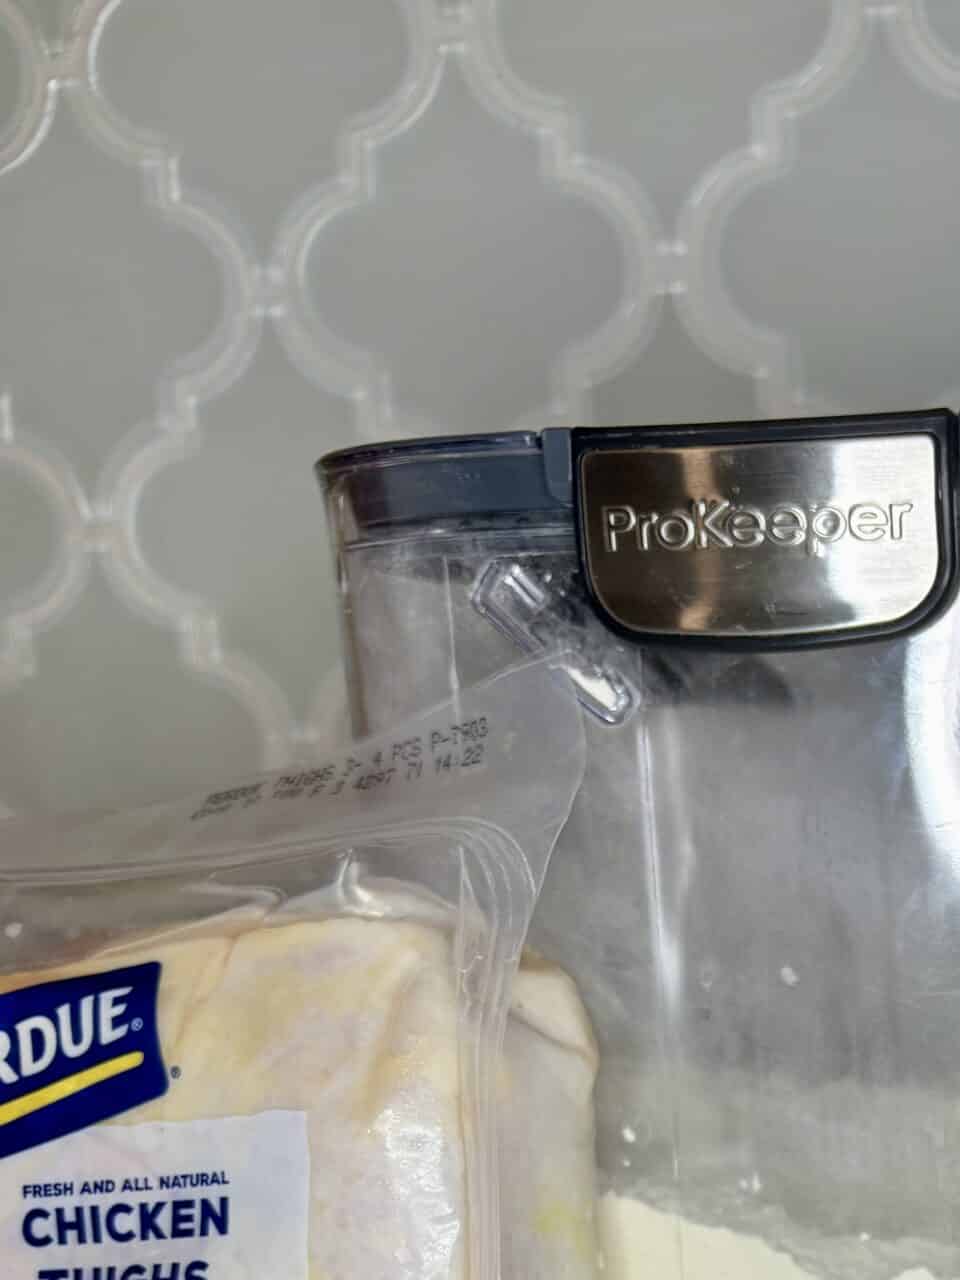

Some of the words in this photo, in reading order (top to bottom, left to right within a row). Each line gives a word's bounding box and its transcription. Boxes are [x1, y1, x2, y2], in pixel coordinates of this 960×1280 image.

[602, 498, 914, 558] ProKeeper
[22, 1182, 74, 1198] FRESH
[80, 1180, 115, 1195] AND
[121, 1177, 153, 1191] ALL
[159, 1171, 229, 1189] NATURAL
[22, 1196, 229, 1248] CHICKEN
